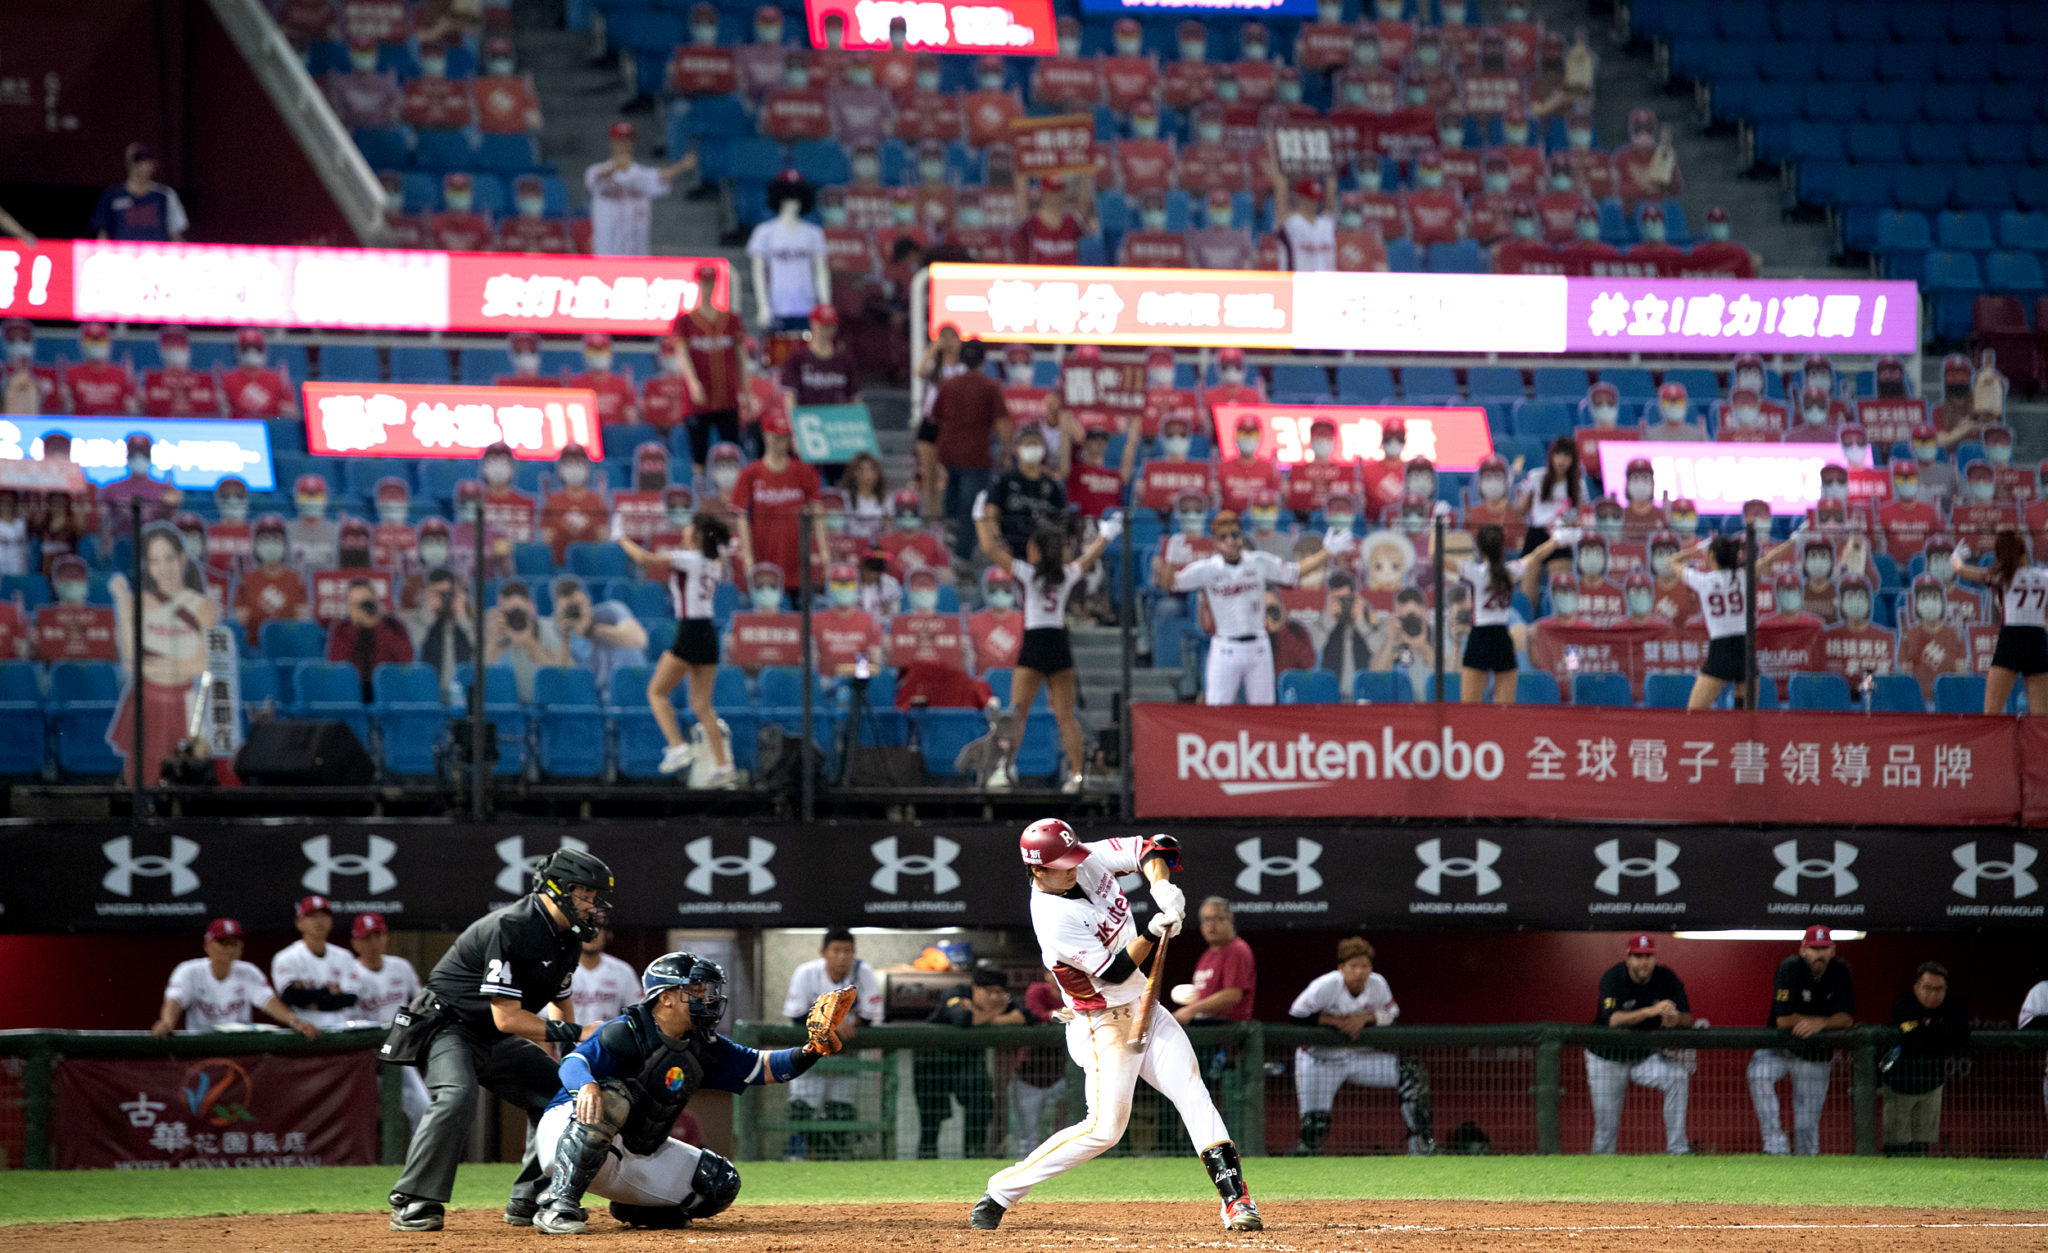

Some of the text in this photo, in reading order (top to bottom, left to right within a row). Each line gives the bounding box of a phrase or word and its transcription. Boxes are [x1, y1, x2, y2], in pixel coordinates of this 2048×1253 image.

[798, 413, 829, 459] 6
[1708, 590, 1743, 617] 99
[2013, 588, 2046, 609] 77
[1756, 649, 1809, 665] akuten
[1177, 725, 1504, 780] Rakuten kobo
[1526, 735, 1974, 788] 全球電子書領導品牌
[1409, 902, 1508, 914] UNDER ARMOUR
[1588, 902, 1686, 914] UNDER ARMOUR
[1767, 903, 1865, 915] UNDER ARMOUR
[1946, 905, 2044, 917] UNDER ARMOUR
[486, 959, 512, 984] 24
[119, 1091, 307, 1154] 古華花園飯店
